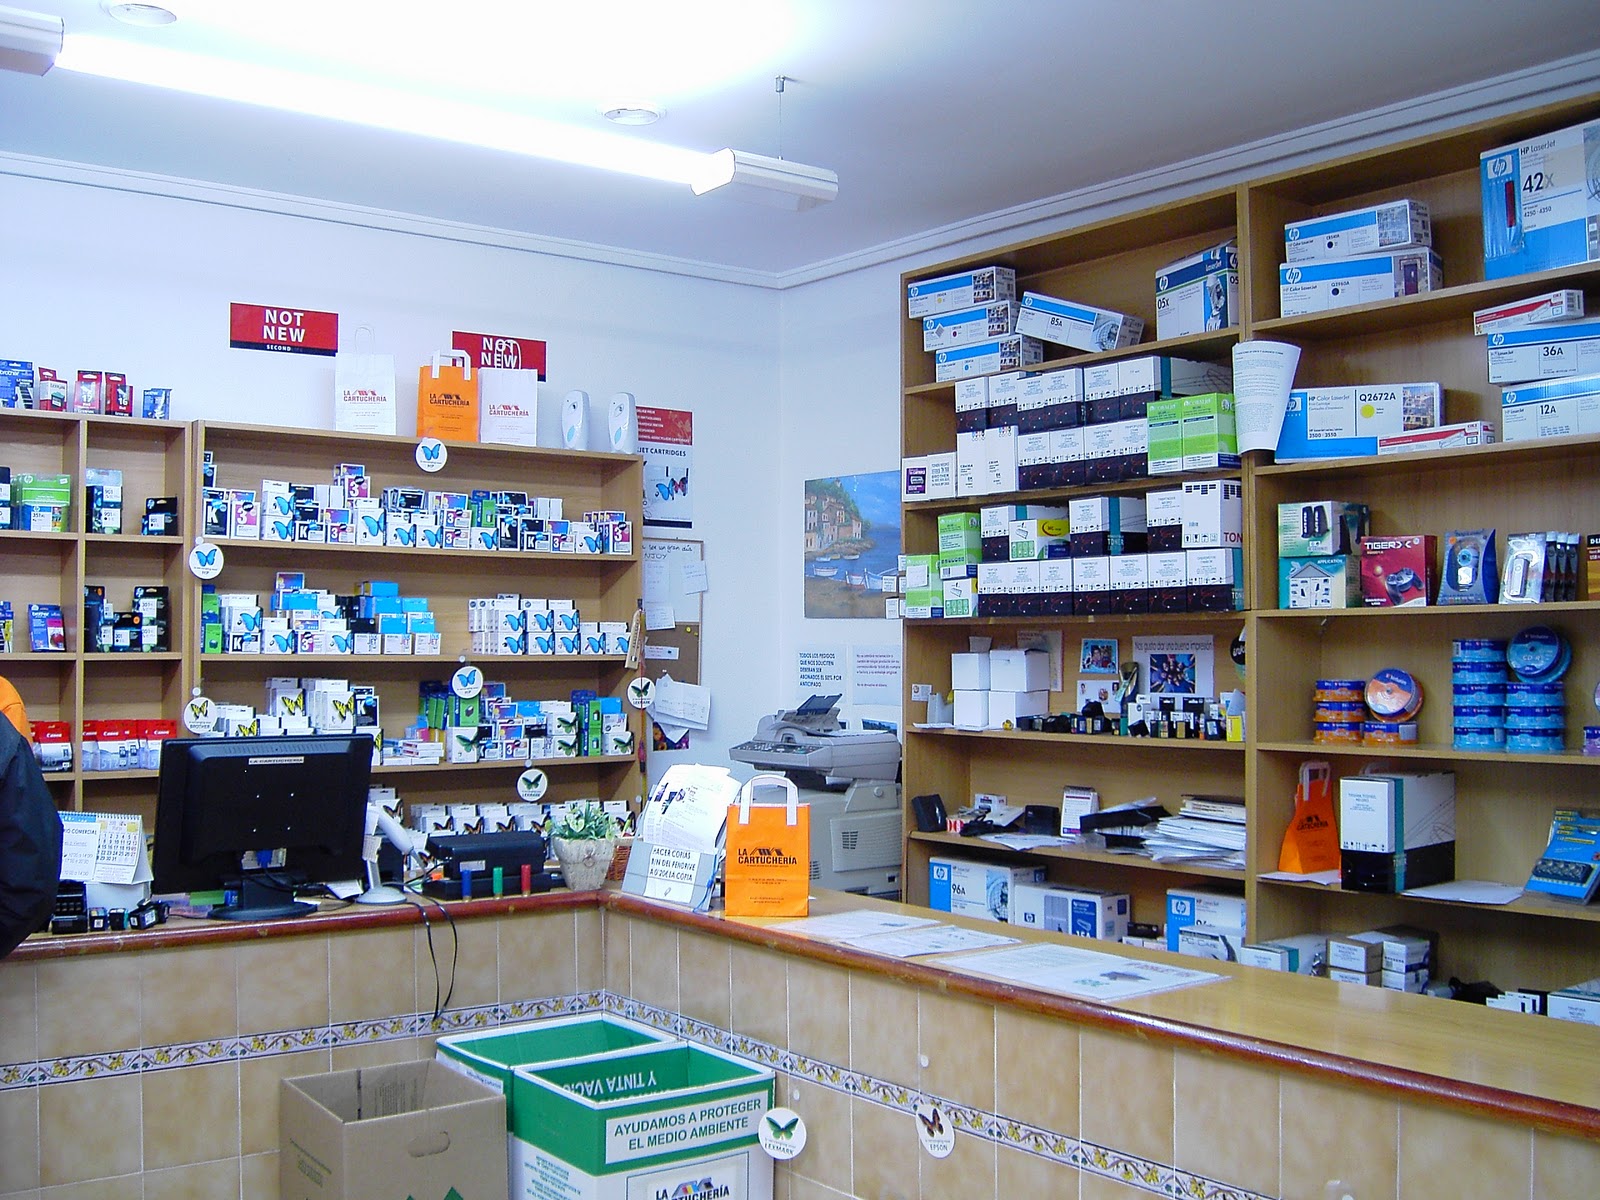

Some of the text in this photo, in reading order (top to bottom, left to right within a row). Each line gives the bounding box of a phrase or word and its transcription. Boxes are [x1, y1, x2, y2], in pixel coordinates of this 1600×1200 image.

[1520, 146, 1530, 155] HP
[264, 309, 304, 327] NOT
[1050, 318, 1063, 327] 85A
[262, 325, 306, 344] NEW
[266, 344, 292, 352] SECOND
[483, 337, 516, 354] NOT
[1543, 346, 1564, 357] 36A
[481, 352, 518, 368] NEW
[1360, 393, 1396, 402] Q2672A
[1540, 405, 1557, 415] 12A
[650, 448, 686, 457] CARTRIDGES
[350, 482, 360, 498] 3
[208, 506, 218, 523] K
[237, 508, 248, 525] 3
[447, 514, 454, 523] 3
[300, 526, 309, 538] K
[332, 527, 338, 538] 3
[501, 523, 510, 538] K
[614, 525, 623, 542] 3
[446, 535, 453, 545] 3
[528, 536, 535, 548] K
[554, 539, 560, 548] 3
[234, 638, 243, 651] K
[302, 638, 310, 651] 3
[358, 701, 366, 715] K
[507, 745, 513, 755] 3
[672, 850, 691, 860] COPIAS
[738, 848, 748, 856] LA
[738, 855, 797, 865] CARTUCHERÍA
[676, 872, 693, 881] COPIA
[952, 884, 966, 896] 96A
[606, 1072, 645, 1093] TINTA
[648, 1071, 657, 1087] Y
[614, 1099, 761, 1138] AYUDAMOS A PROTEGER
[629, 1116, 749, 1151] EL MEDIO AMBIENTE
[765, 1143, 793, 1156] LEXMARK
[656, 1189, 668, 1200] LA
[672, 1184, 730, 1200] TUCHERÍA
